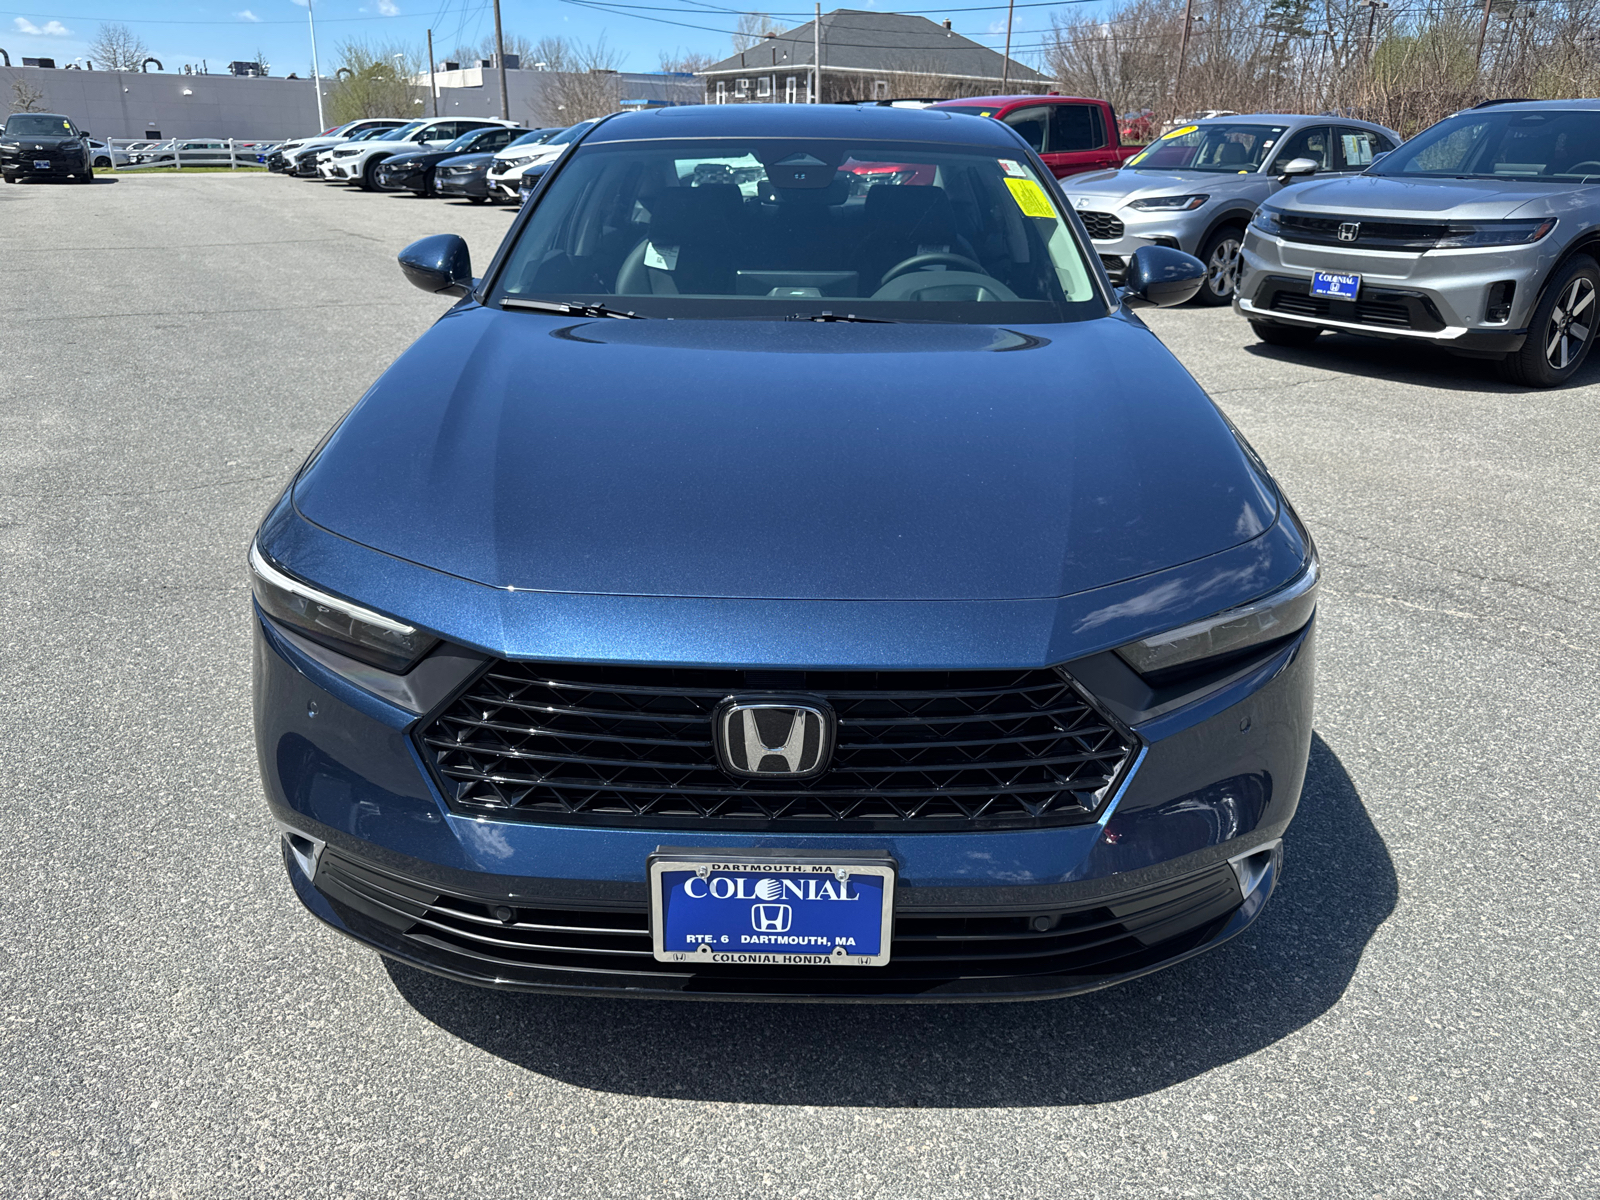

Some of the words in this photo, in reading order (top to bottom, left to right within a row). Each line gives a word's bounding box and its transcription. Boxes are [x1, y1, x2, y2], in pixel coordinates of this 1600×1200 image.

[711, 863, 807, 873] DARTMOUTH,
[683, 876, 860, 901] COLONIAL
[686, 934, 717, 944] RTE.
[720, 934, 730, 944] 6
[740, 935, 831, 947] DARTMOUTH,
[835, 937, 856, 946] MA
[712, 953, 779, 964] COLONIAL
[783, 955, 832, 965] HONDA
